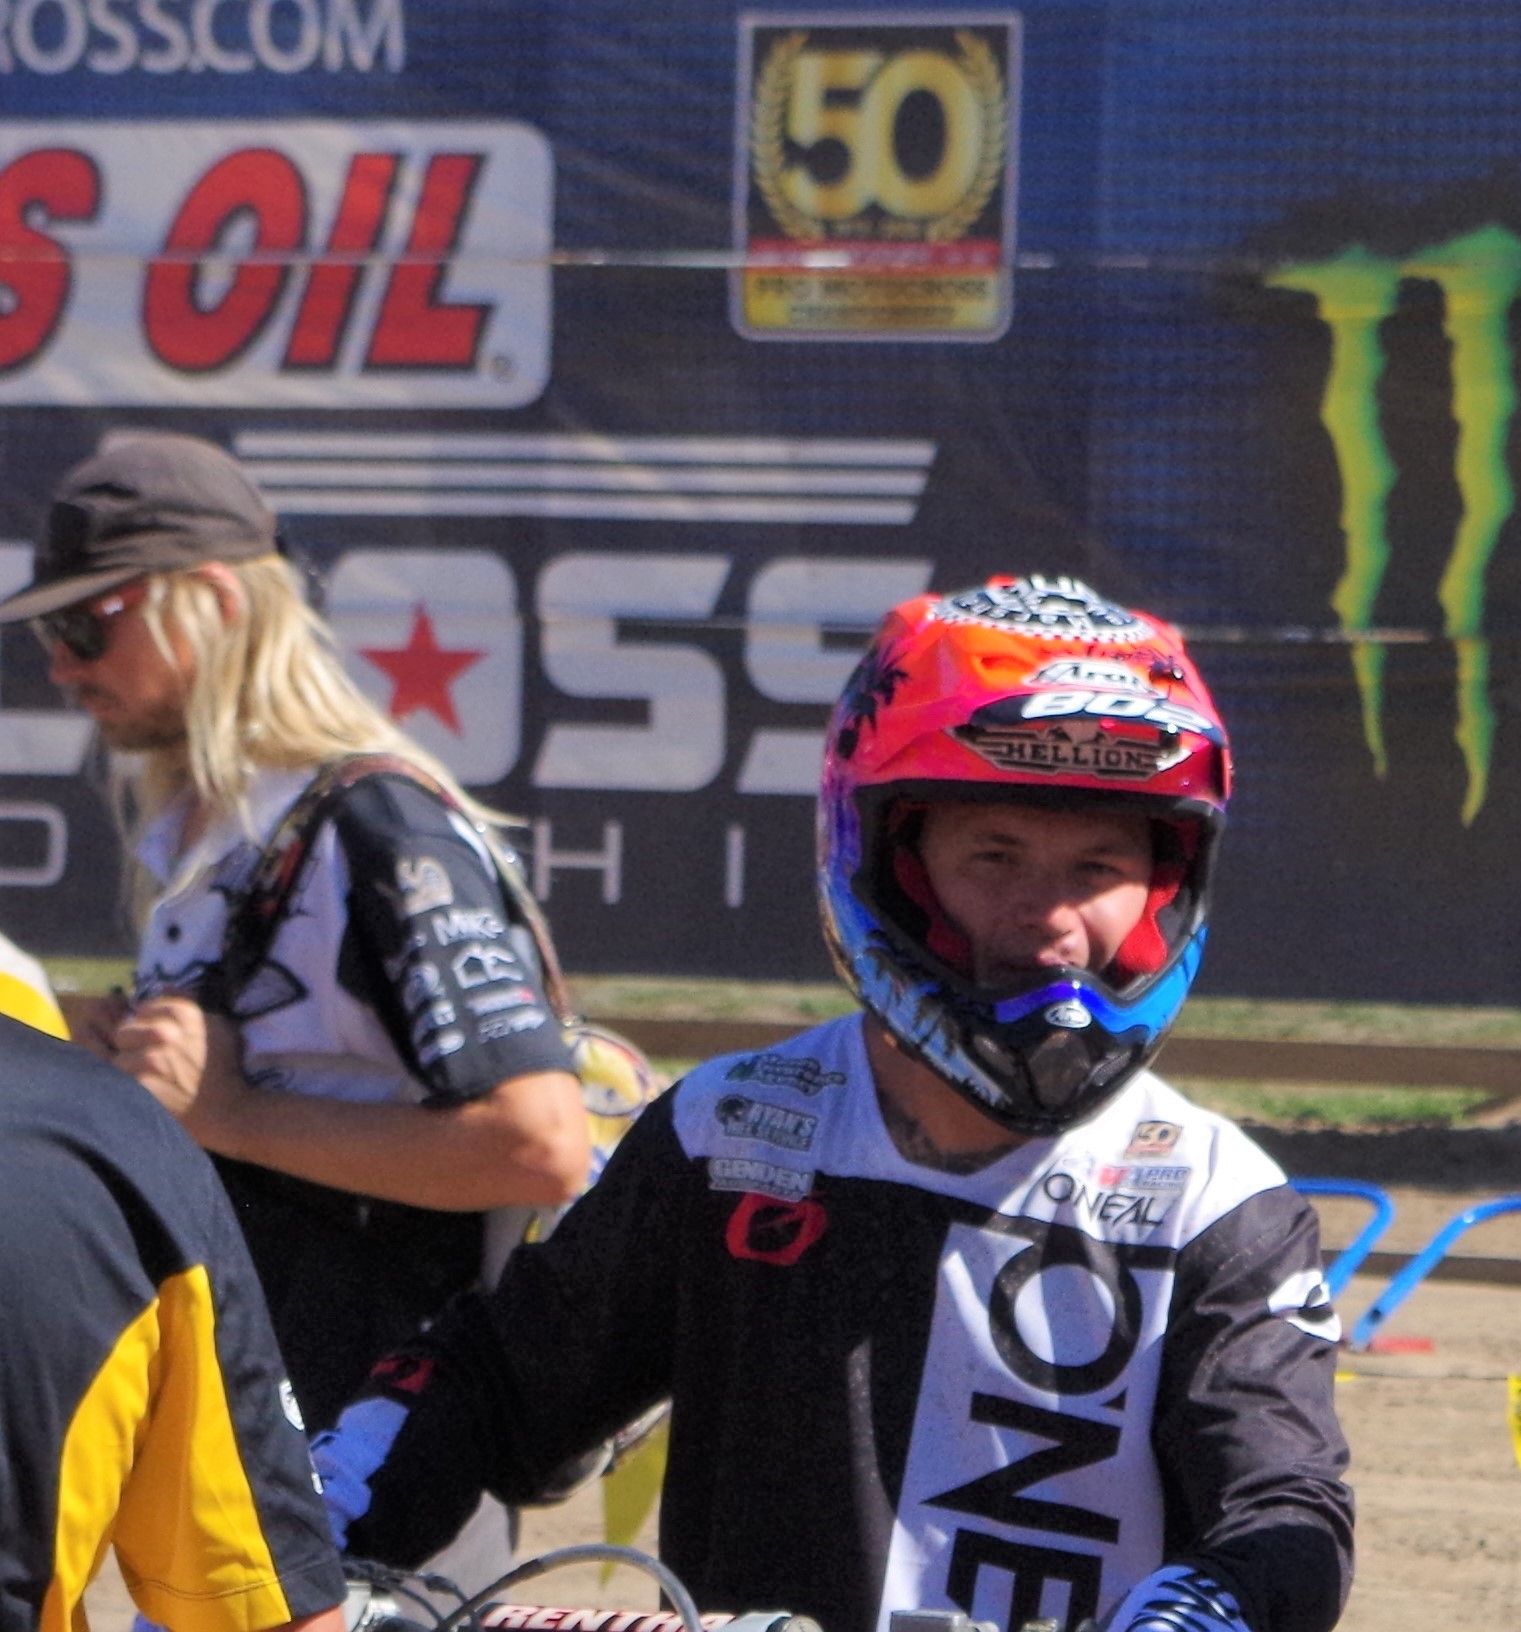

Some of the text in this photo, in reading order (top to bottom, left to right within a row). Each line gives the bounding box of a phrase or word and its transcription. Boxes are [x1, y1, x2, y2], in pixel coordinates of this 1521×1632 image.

[0, 0, 404, 74] OSS.COM
[777, 52, 985, 222] 50
[143, 147, 490, 374] OIL
[1021, 692, 1214, 734] 802
[1004, 740, 1144, 769] HELLION
